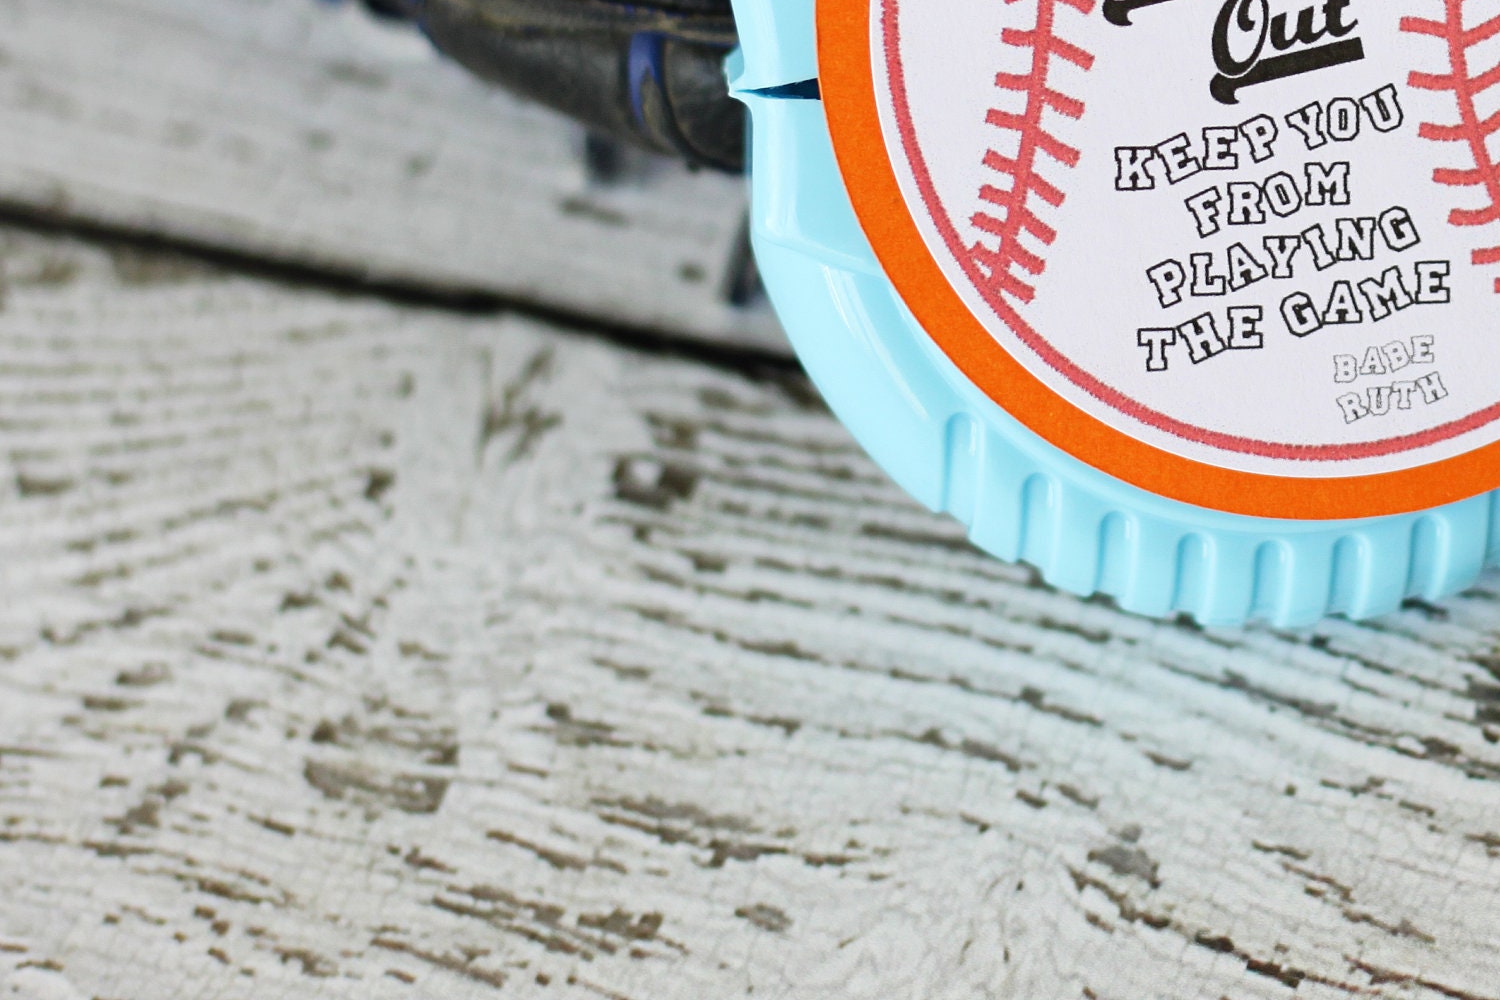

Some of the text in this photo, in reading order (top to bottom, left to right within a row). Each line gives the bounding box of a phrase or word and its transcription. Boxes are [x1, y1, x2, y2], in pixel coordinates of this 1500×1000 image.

[1114, 83, 1404, 192] KEEP YOU
[1185, 161, 1351, 238] FROM
[1146, 205, 1421, 309] PLAYING
[1137, 260, 1451, 372] THE GAME
[1333, 334, 1435, 384] BABE
[1336, 371, 1449, 424] RUTH
